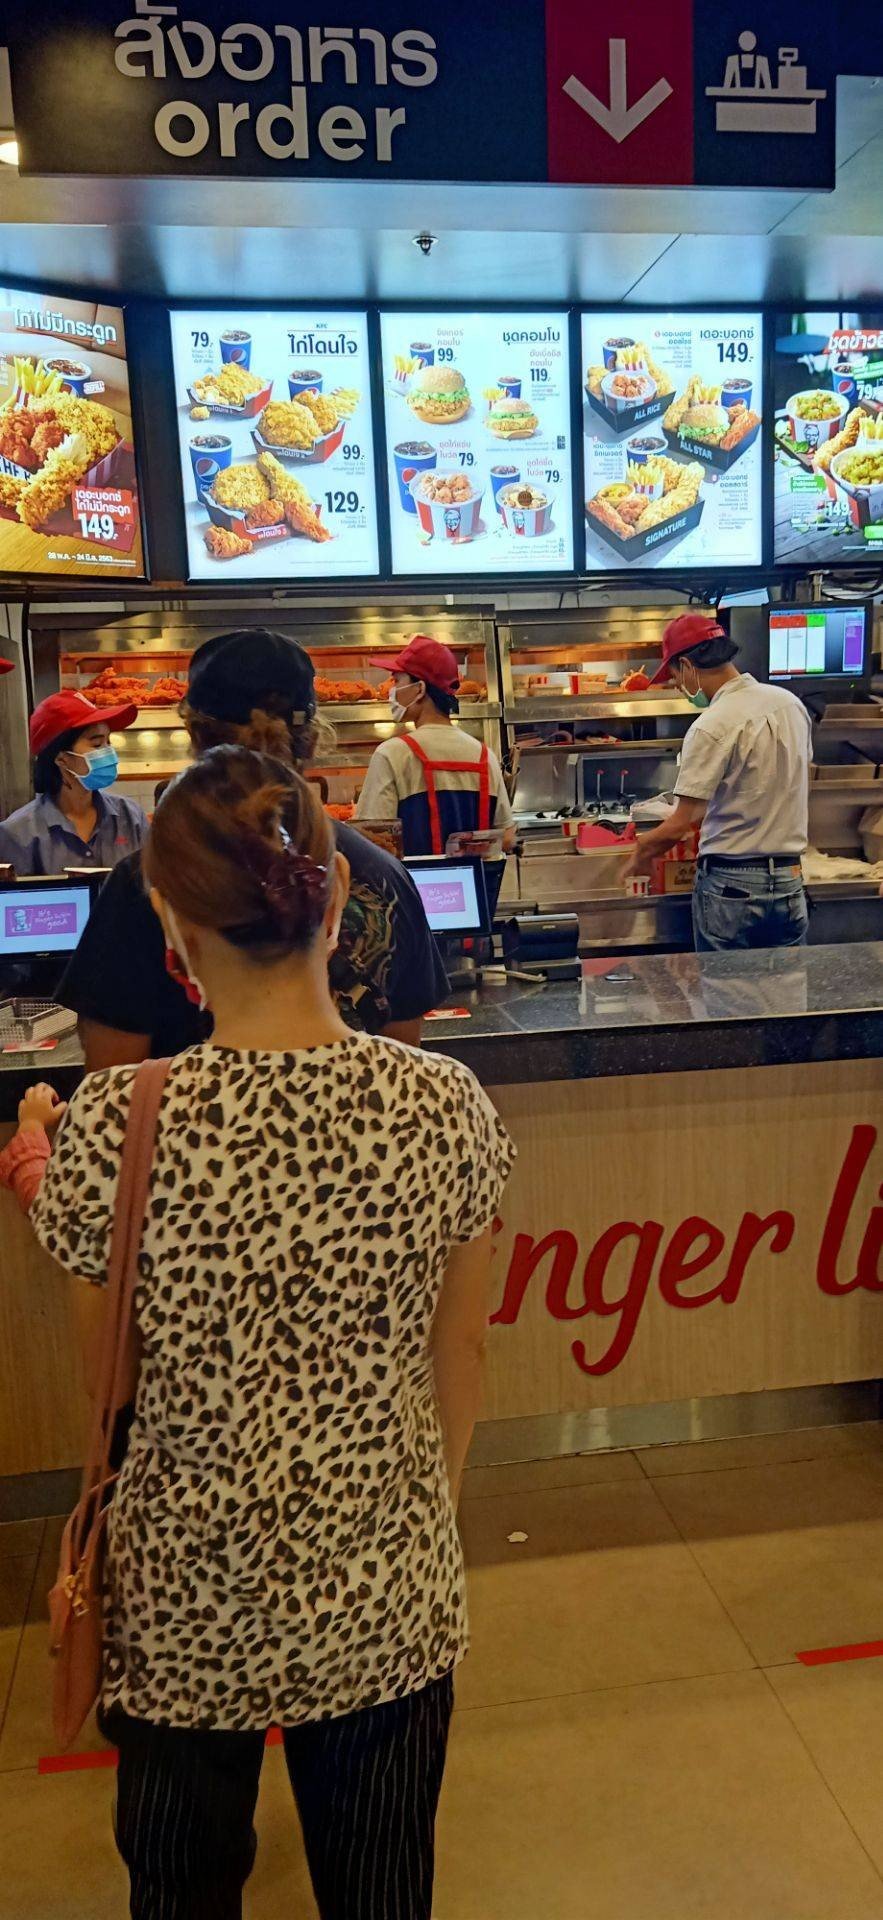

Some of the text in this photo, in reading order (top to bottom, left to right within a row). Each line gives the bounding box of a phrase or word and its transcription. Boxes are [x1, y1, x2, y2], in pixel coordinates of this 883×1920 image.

[154, 86, 406, 162] order
[287, 333, 358, 354] ไก่โดนใจ
[503, 327, 560, 346] ชุดคอมโบ
[700, 326, 754, 339] เดอะบอกซ์
[717, 342, 754, 363] 149.-
[325, 490, 365, 514] 129.-
[645, 516, 687, 546] SIGNATURE
[489, 1210, 795, 1375] nger
